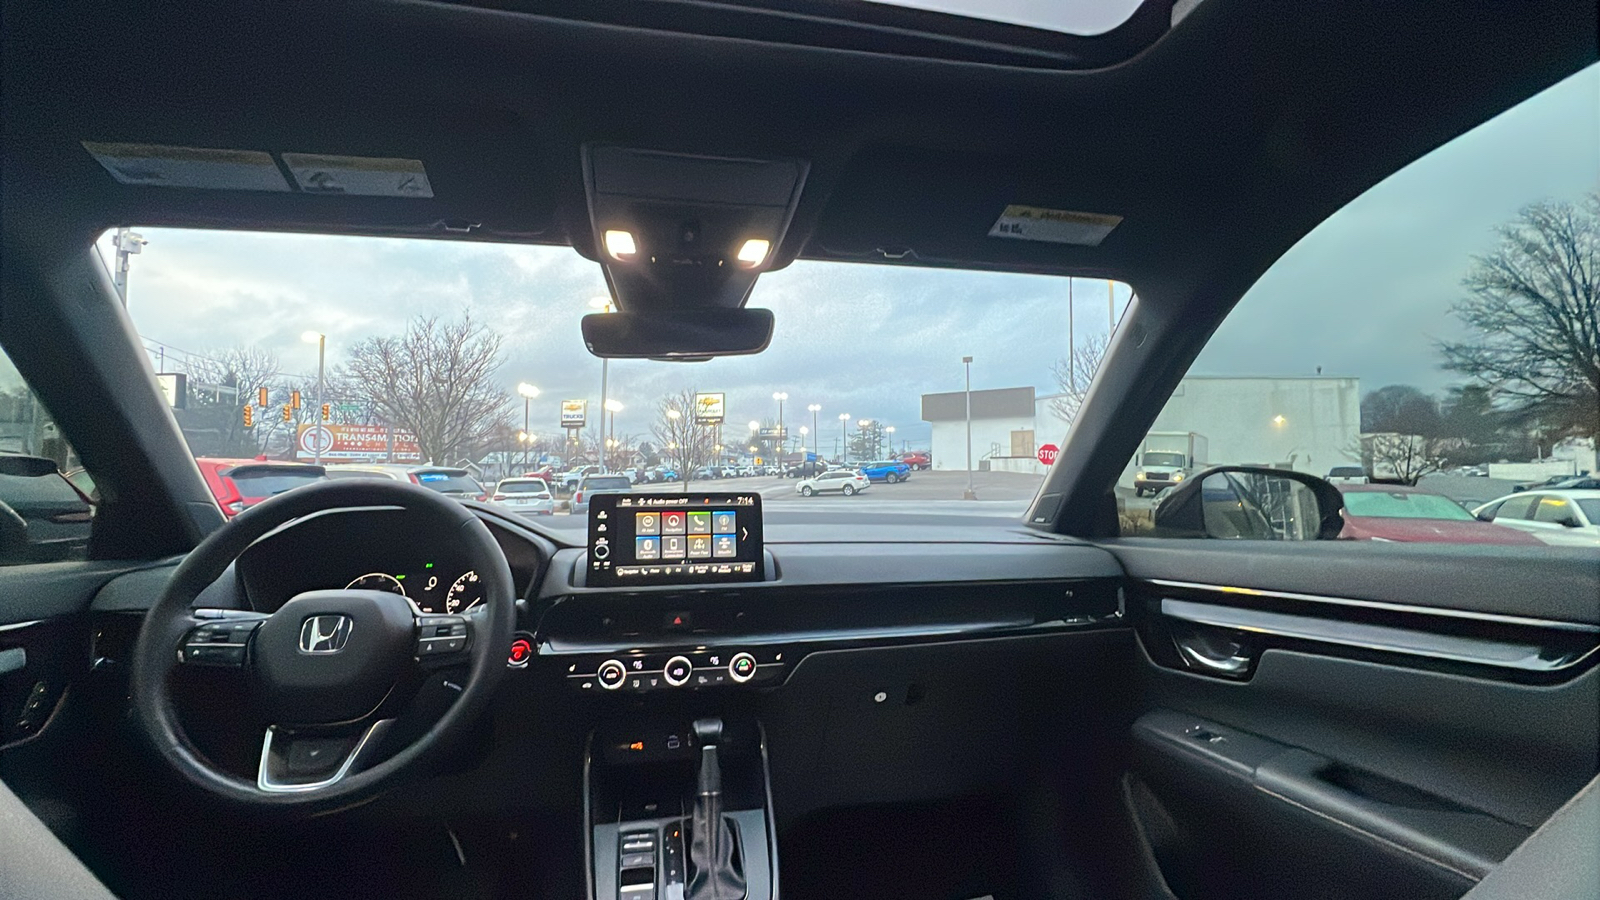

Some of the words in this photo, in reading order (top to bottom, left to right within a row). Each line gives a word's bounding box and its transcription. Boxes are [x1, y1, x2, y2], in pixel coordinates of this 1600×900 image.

[336, 432, 419, 443] TRANS4MTION
[737, 496, 754, 505] 7:14
[456, 584, 465, 592] 40
[451, 599, 460, 607] 20
